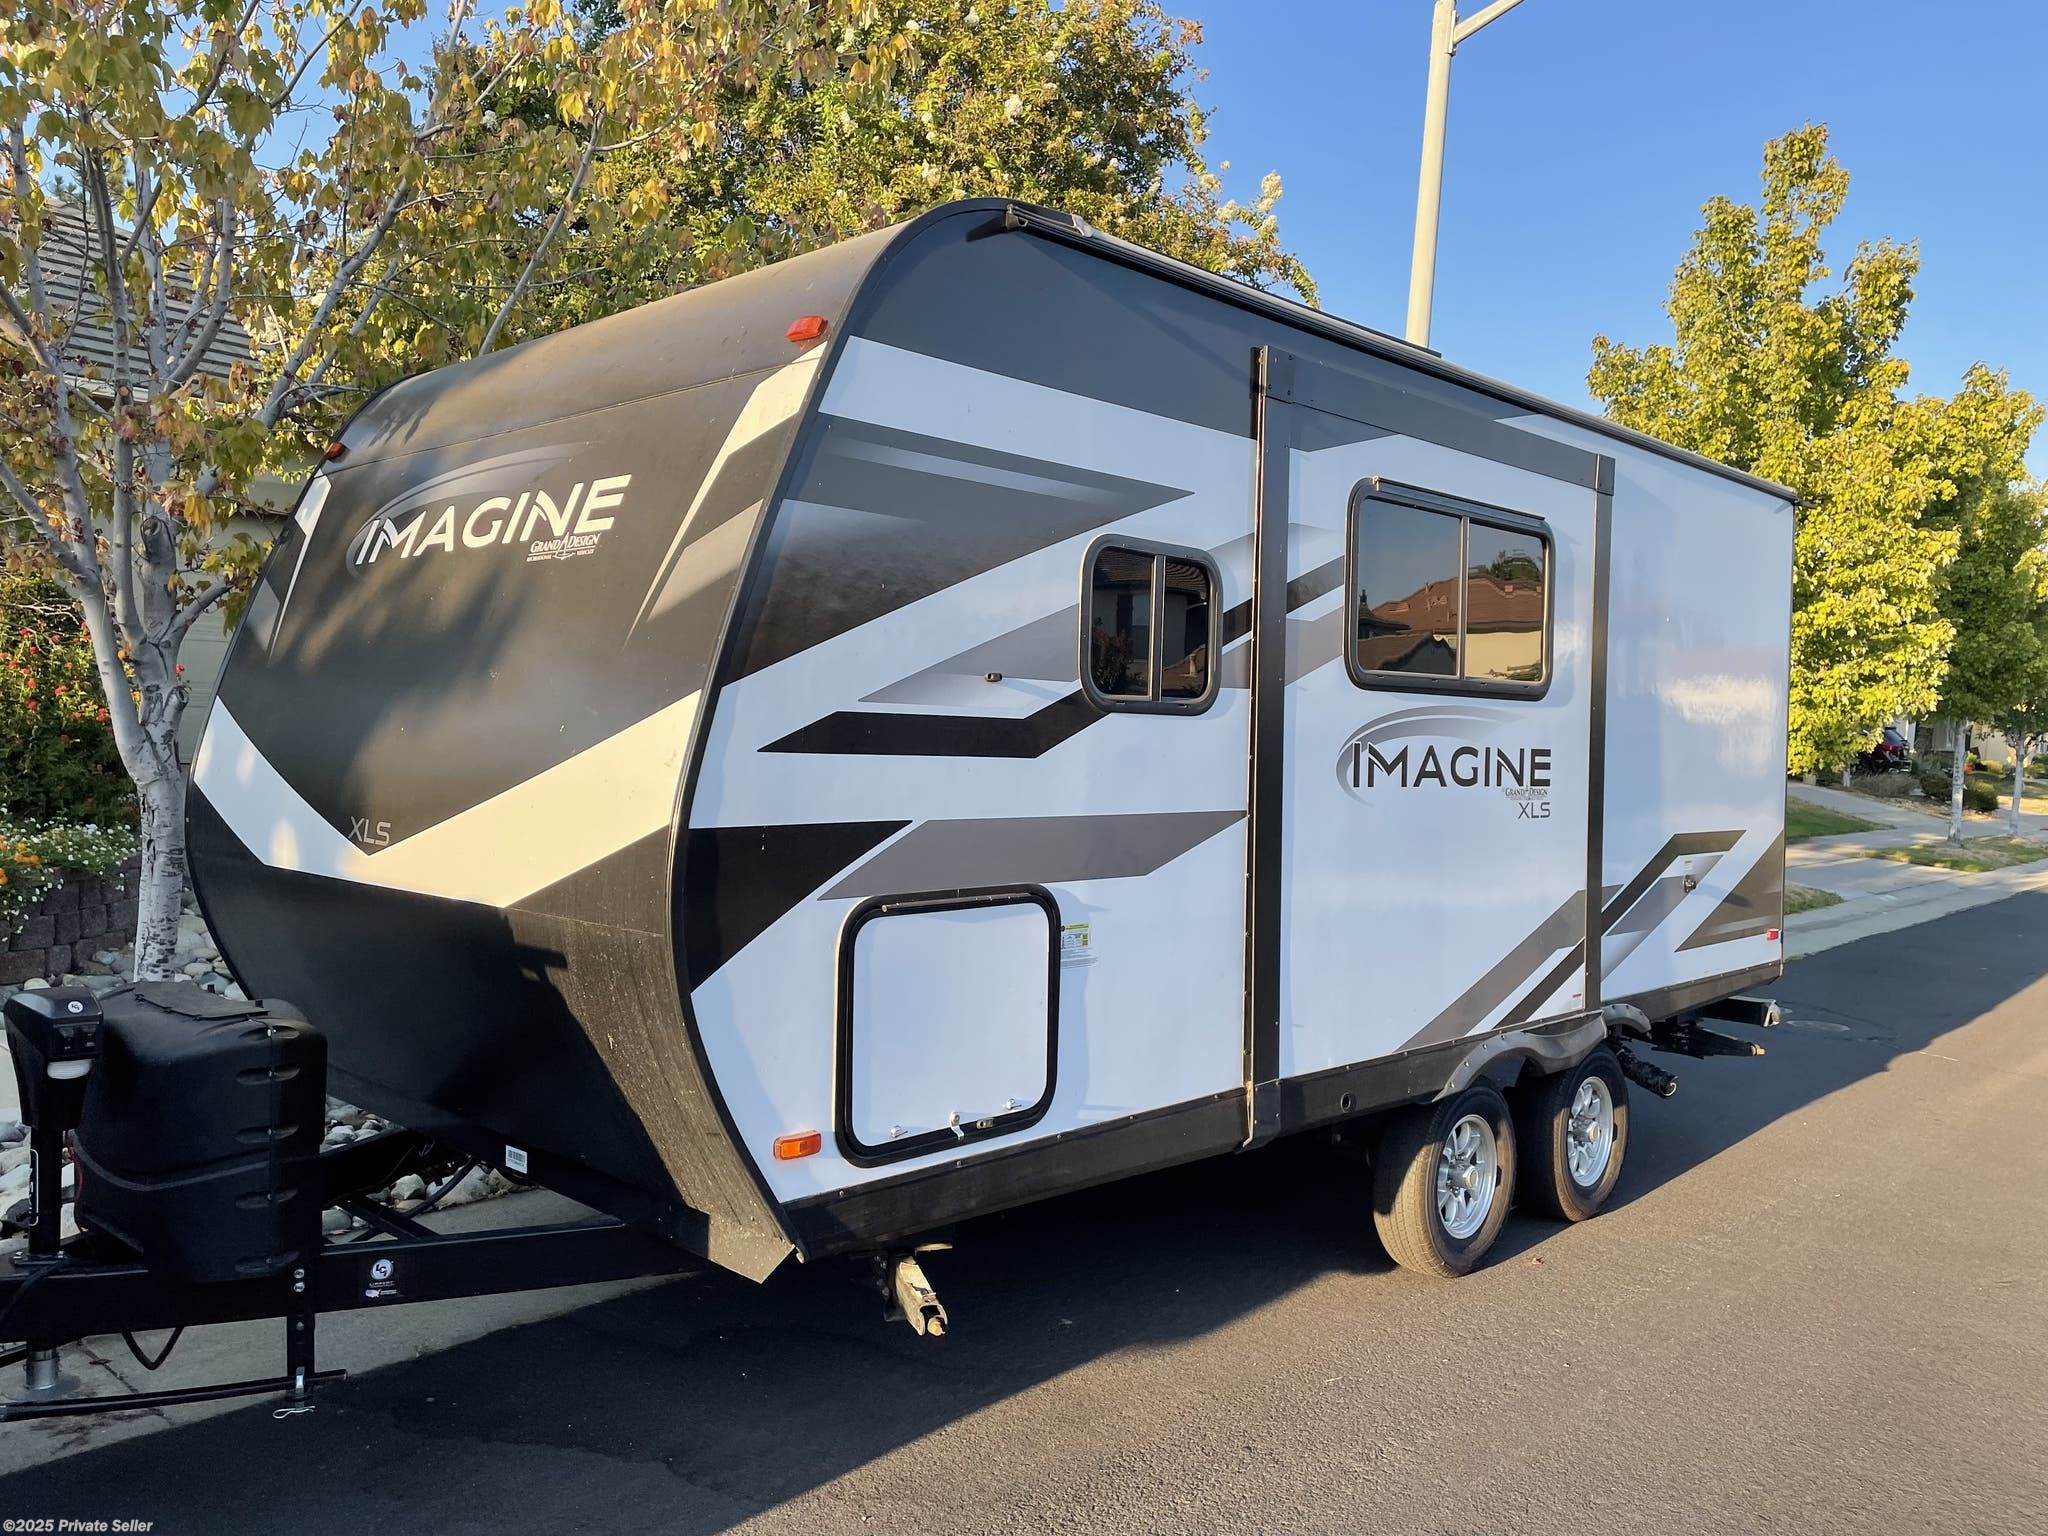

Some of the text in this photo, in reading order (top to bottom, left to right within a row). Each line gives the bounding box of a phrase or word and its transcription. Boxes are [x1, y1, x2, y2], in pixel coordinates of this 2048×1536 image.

[355, 474, 632, 566] IMAGINE
[530, 540, 561, 554] GRAND
[567, 532, 602, 549] DESIGN
[1353, 742, 1552, 788] IMAGINE
[1518, 801, 1551, 819] XLS
[348, 815, 392, 846] XLS
